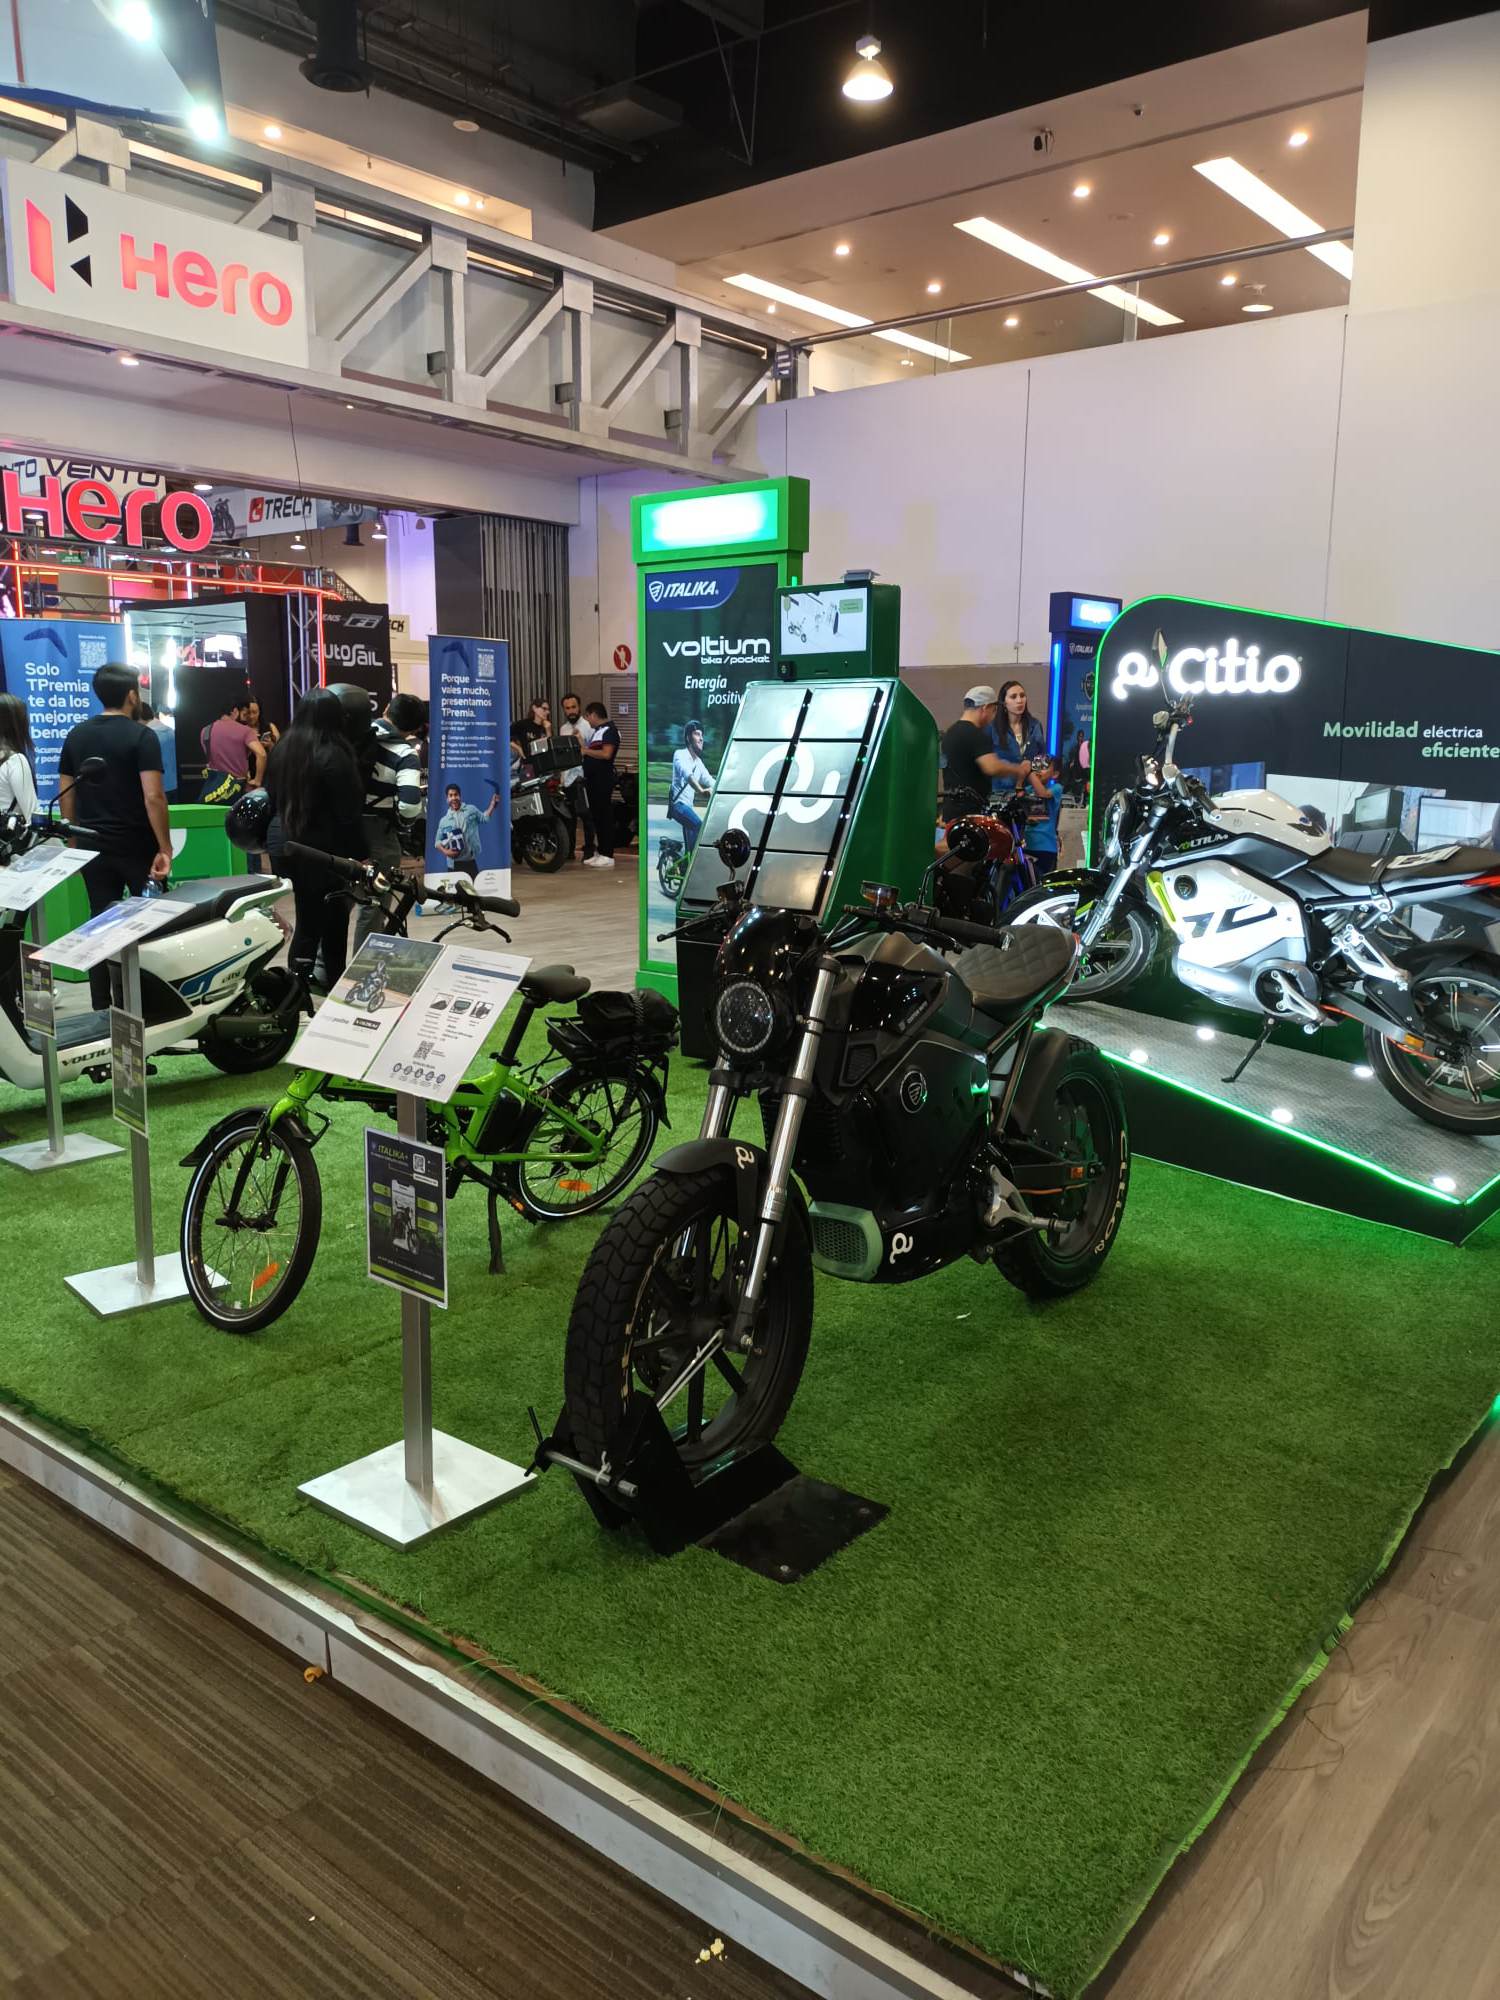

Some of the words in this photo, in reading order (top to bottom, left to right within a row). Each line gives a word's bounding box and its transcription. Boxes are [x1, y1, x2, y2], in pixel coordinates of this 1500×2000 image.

[120, 233, 293, 327] Hero
[2, 469, 214, 552] Hero
[663, 581, 717, 598] ITALIKA
[662, 635, 771, 657] voltium
[24, 662, 60, 676] Solo
[1168, 637, 1301, 695] Citio
[26, 678, 90, 692] TPremia
[441, 673, 470, 684] Porque
[685, 674, 727, 692] Energía
[441, 686, 462, 695] vales
[463, 686, 491, 697] mucho,
[28, 694, 46, 707] te
[48, 694, 67, 707] da
[69, 694, 90, 708] los
[441, 698, 492, 708] presentamos
[29, 709, 89, 726] mejores
[1323, 720, 1418, 739] Movilidad
[1423, 725, 1483, 739] eléctrica
[1421, 741, 1500, 759] eficiente
[1174, 833, 1229, 851] VOLTIUM
